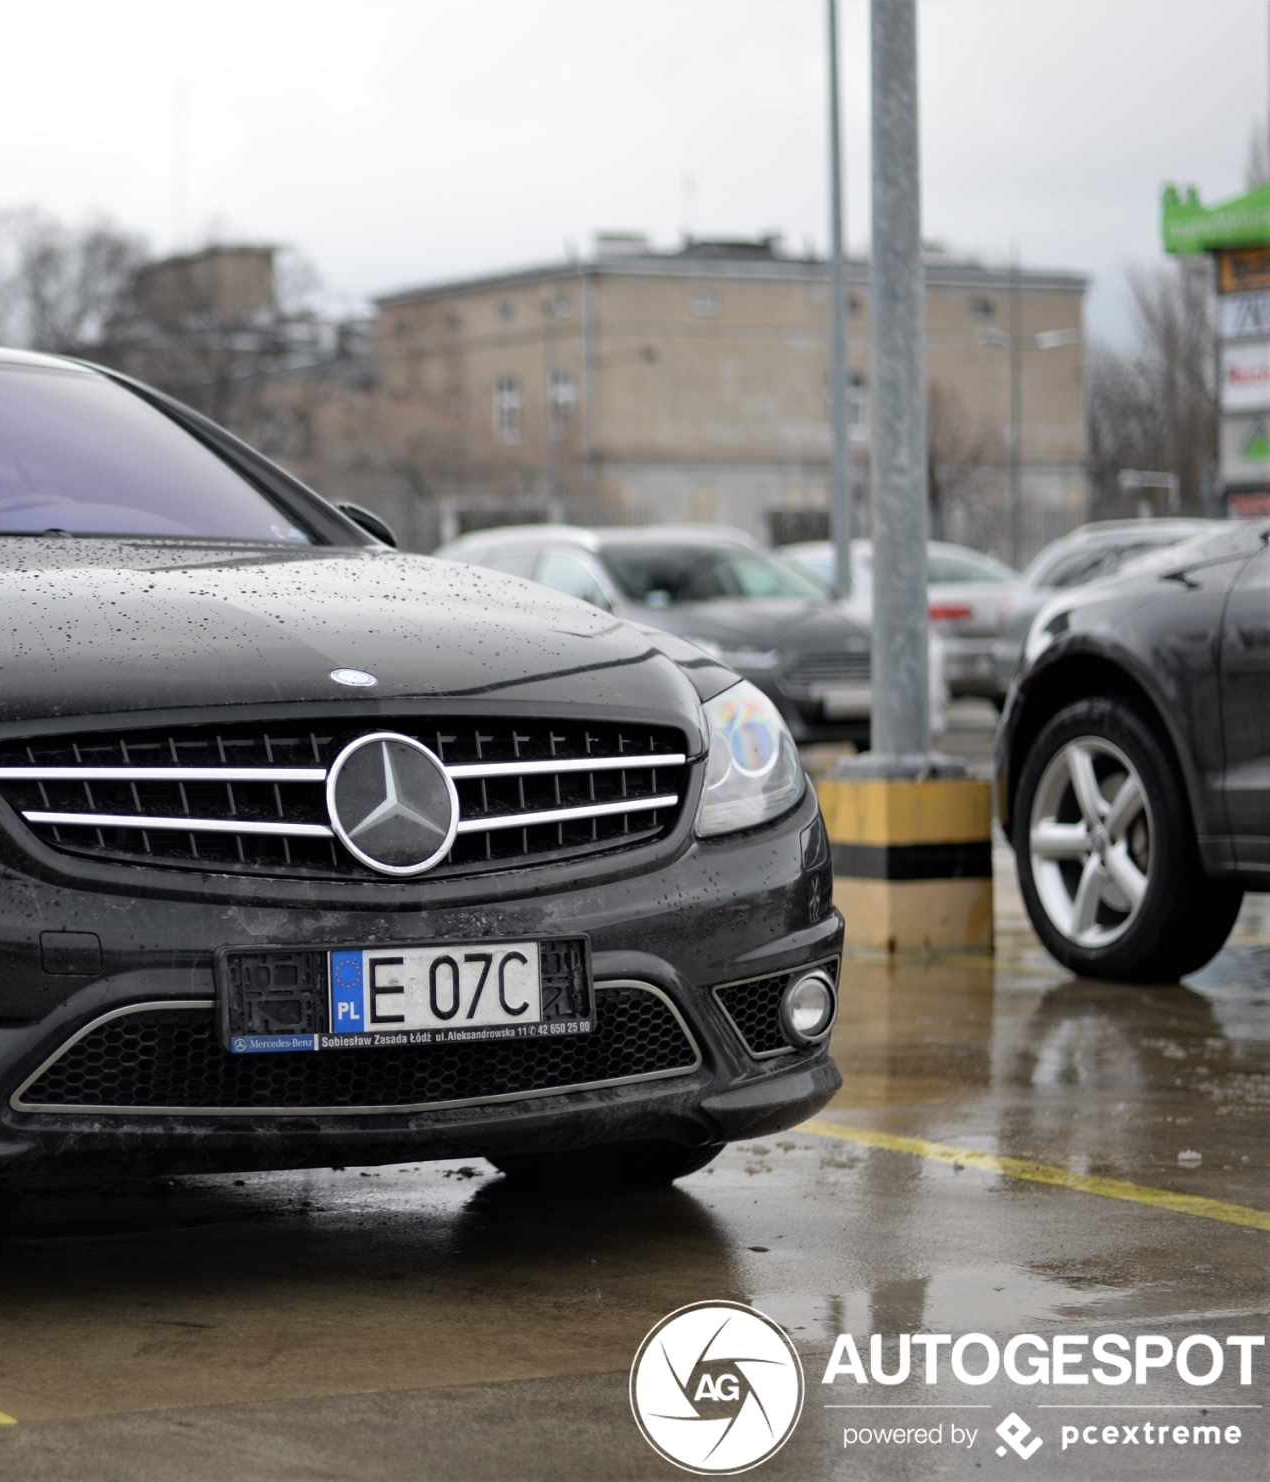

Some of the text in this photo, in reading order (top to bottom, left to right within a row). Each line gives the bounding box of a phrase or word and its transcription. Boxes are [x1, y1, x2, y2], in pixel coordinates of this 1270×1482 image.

[368, 950, 530, 1024] E 07C
[337, 1001, 360, 1020] PL
[250, 1038, 313, 1049] Mercedes-Benz
[321, 1035, 372, 1048] Sobiesław
[373, 1033, 408, 1045] Zasada
[409, 1031, 432, 1043] Łódź
[518, 1026, 527, 1036] 11
[538, 1025, 549, 1035] 42
[550, 1023, 566, 1034] 650
[567, 1022, 578, 1033] 25
[579, 1021, 590, 1032] 00
